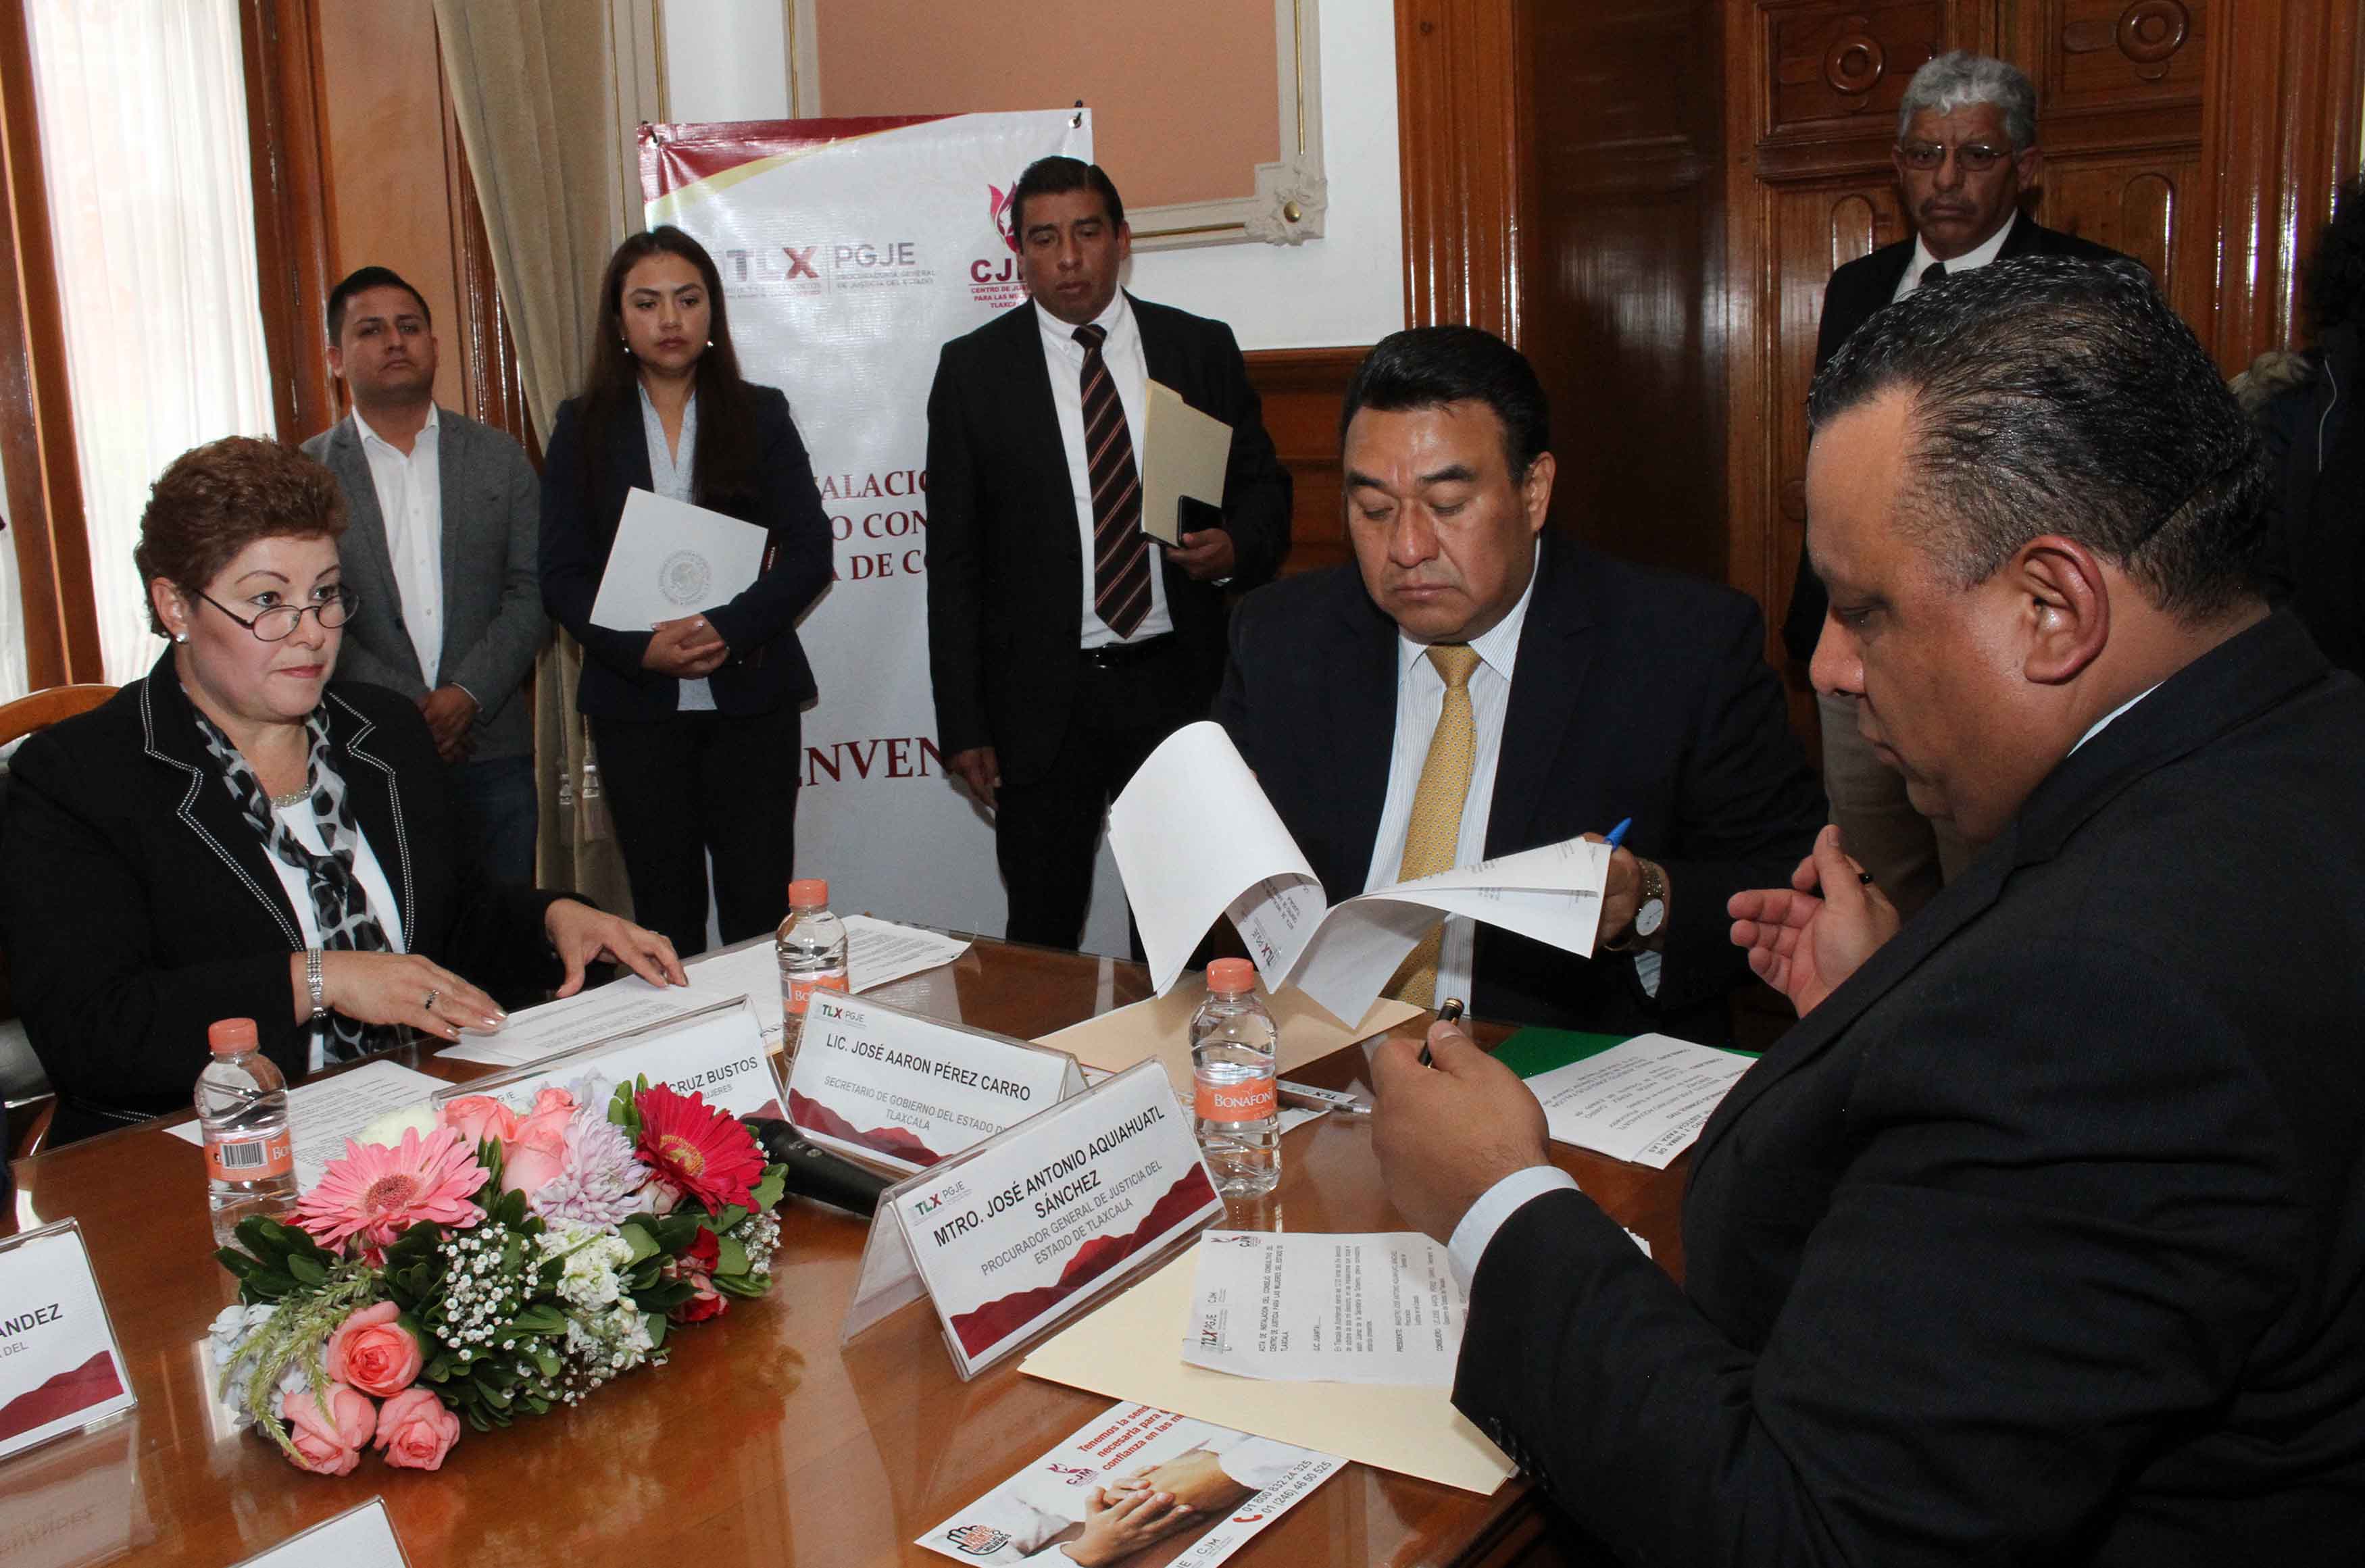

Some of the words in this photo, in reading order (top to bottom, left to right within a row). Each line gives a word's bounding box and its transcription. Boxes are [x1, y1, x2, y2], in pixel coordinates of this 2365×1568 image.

[835, 242, 916, 269] PGJE
[849, 553, 893, 580] DE
[822, 1004, 843, 1019] TLX
[845, 1011, 865, 1022] PGJE
[669, 1074, 705, 1093] CRUZ
[707, 1057, 758, 1084] BUSTOS
[826, 1033, 848, 1053] LIC.
[851, 1040, 883, 1061] JOSÉ
[885, 1050, 932, 1075] AARON
[934, 1058, 978, 1088] PÉREZ
[980, 1076, 1031, 1102] CARRO
[703, 1084, 732, 1100] UJERES
[824, 1075, 875, 1098] SECRETARIO
[875, 1090, 889, 1104] DE
[889, 1094, 936, 1118] GOBIERNO
[937, 1109, 955, 1123] DEL
[956, 1113, 994, 1135] ESTADO
[886, 1109, 931, 1131] TLAXCALA
[933, 1210, 984, 1248] MTRO.
[987, 1181, 1025, 1218] JOSÉ
[1025, 1150, 1087, 1198] ANTONIO
[1089, 1105, 1166, 1160] AQUIAHUATL
[1034, 1169, 1102, 1219] SÁNCHEZ
[915, 1193, 943, 1215] TLX
[942, 1181, 965, 1199] PGJE
[980, 1228, 1051, 1277] PROCURADOR
[1050, 1203, 1096, 1240] GENERAL
[1094, 1194, 1110, 1213] DE
[1108, 1169, 1145, 1200] JUSTICIA
[1143, 1160, 1164, 1179] DEL
[1033, 1237, 1073, 1265] ESTADO
[1071, 1226, 1088, 1246] DE
[1086, 1198, 1135, 1238] TLAXCALA
[1201, 1330, 1218, 1346] TLX
[1205, 1314, 1216, 1330] PGJE
[3, 1342, 29, 1357] DEL
[1076, 1425, 1120, 1452] Tenemos
[1117, 1418, 1129, 1427] la
[1097, 1427, 1141, 1458] necesaria
[1140, 1413, 1162, 1429] para
[1102, 1439, 1147, 1471] confianza
[1145, 1431, 1160, 1441] en
[1155, 1421, 1173, 1432] las
[1066, 1467, 1094, 1486] CJM
[1242, 1503, 1257, 1513] 01
[1253, 1492, 1272, 1504] 800
[1268, 1480, 1288, 1493] 832
[1283, 1471, 1298, 1484] 24
[1261, 1504, 1276, 1514] 01
[1273, 1488, 1298, 1507] (246)
[1293, 1480, 1308, 1490] 46
[1313, 1461, 1333, 1475] 525
